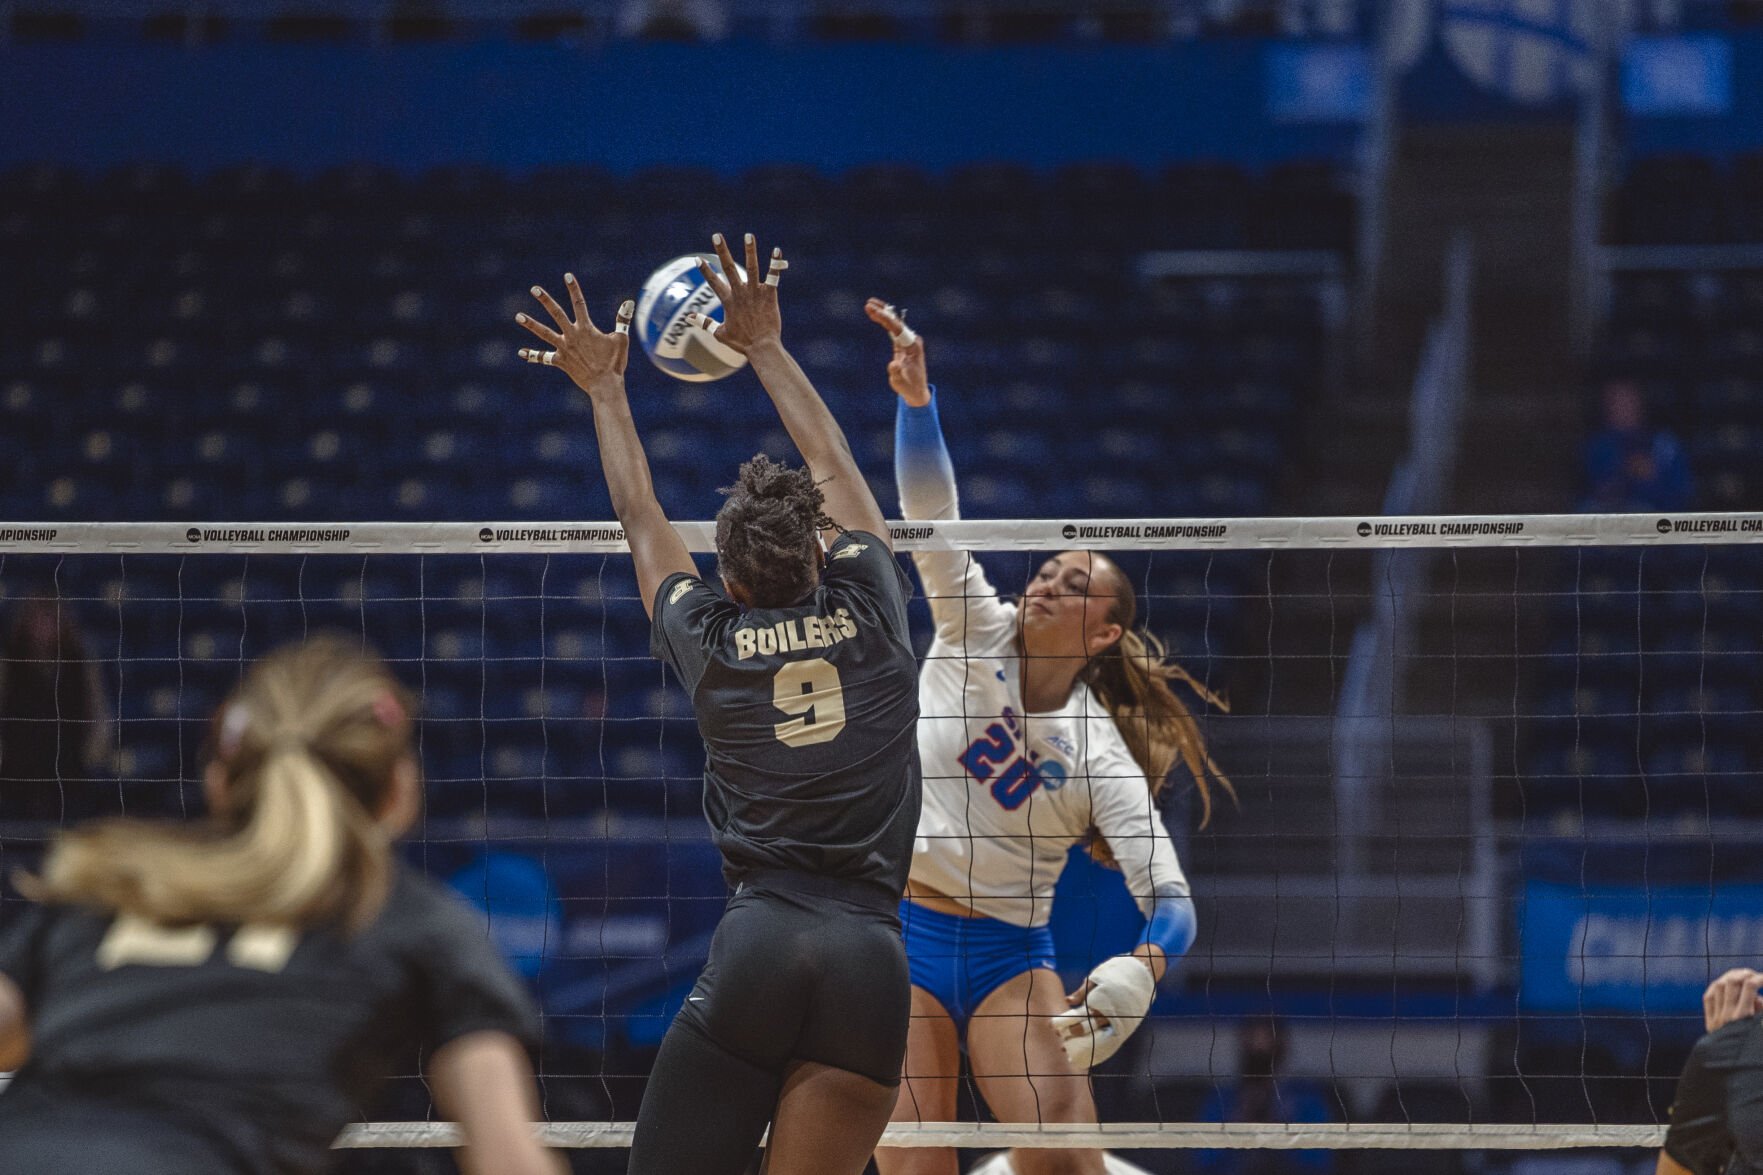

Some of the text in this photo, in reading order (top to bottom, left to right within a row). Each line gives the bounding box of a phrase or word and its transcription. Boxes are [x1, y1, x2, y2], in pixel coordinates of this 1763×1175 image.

[1079, 526, 1141, 538] VOLLEYBALL
[1143, 525, 1227, 538] CHAMPIONSHIP
[1374, 523, 1437, 535] VOLLEYBALL
[1440, 522, 1524, 535] CHAMPIONSHIP
[1674, 520, 1738, 532] VOLLEYBALL
[1740, 519, 1763, 532] CHA
[203, 529, 265, 542] VOLLEYBALL
[268, 529, 350, 542] CHAMPIONSHIP
[496, 529, 557, 541] VOLLEYBALL
[735, 607, 858, 661] BOILERS
[772, 657, 846, 748] 9
[1047, 735, 1075, 755] ACC
[957, 723, 1044, 811] 20
